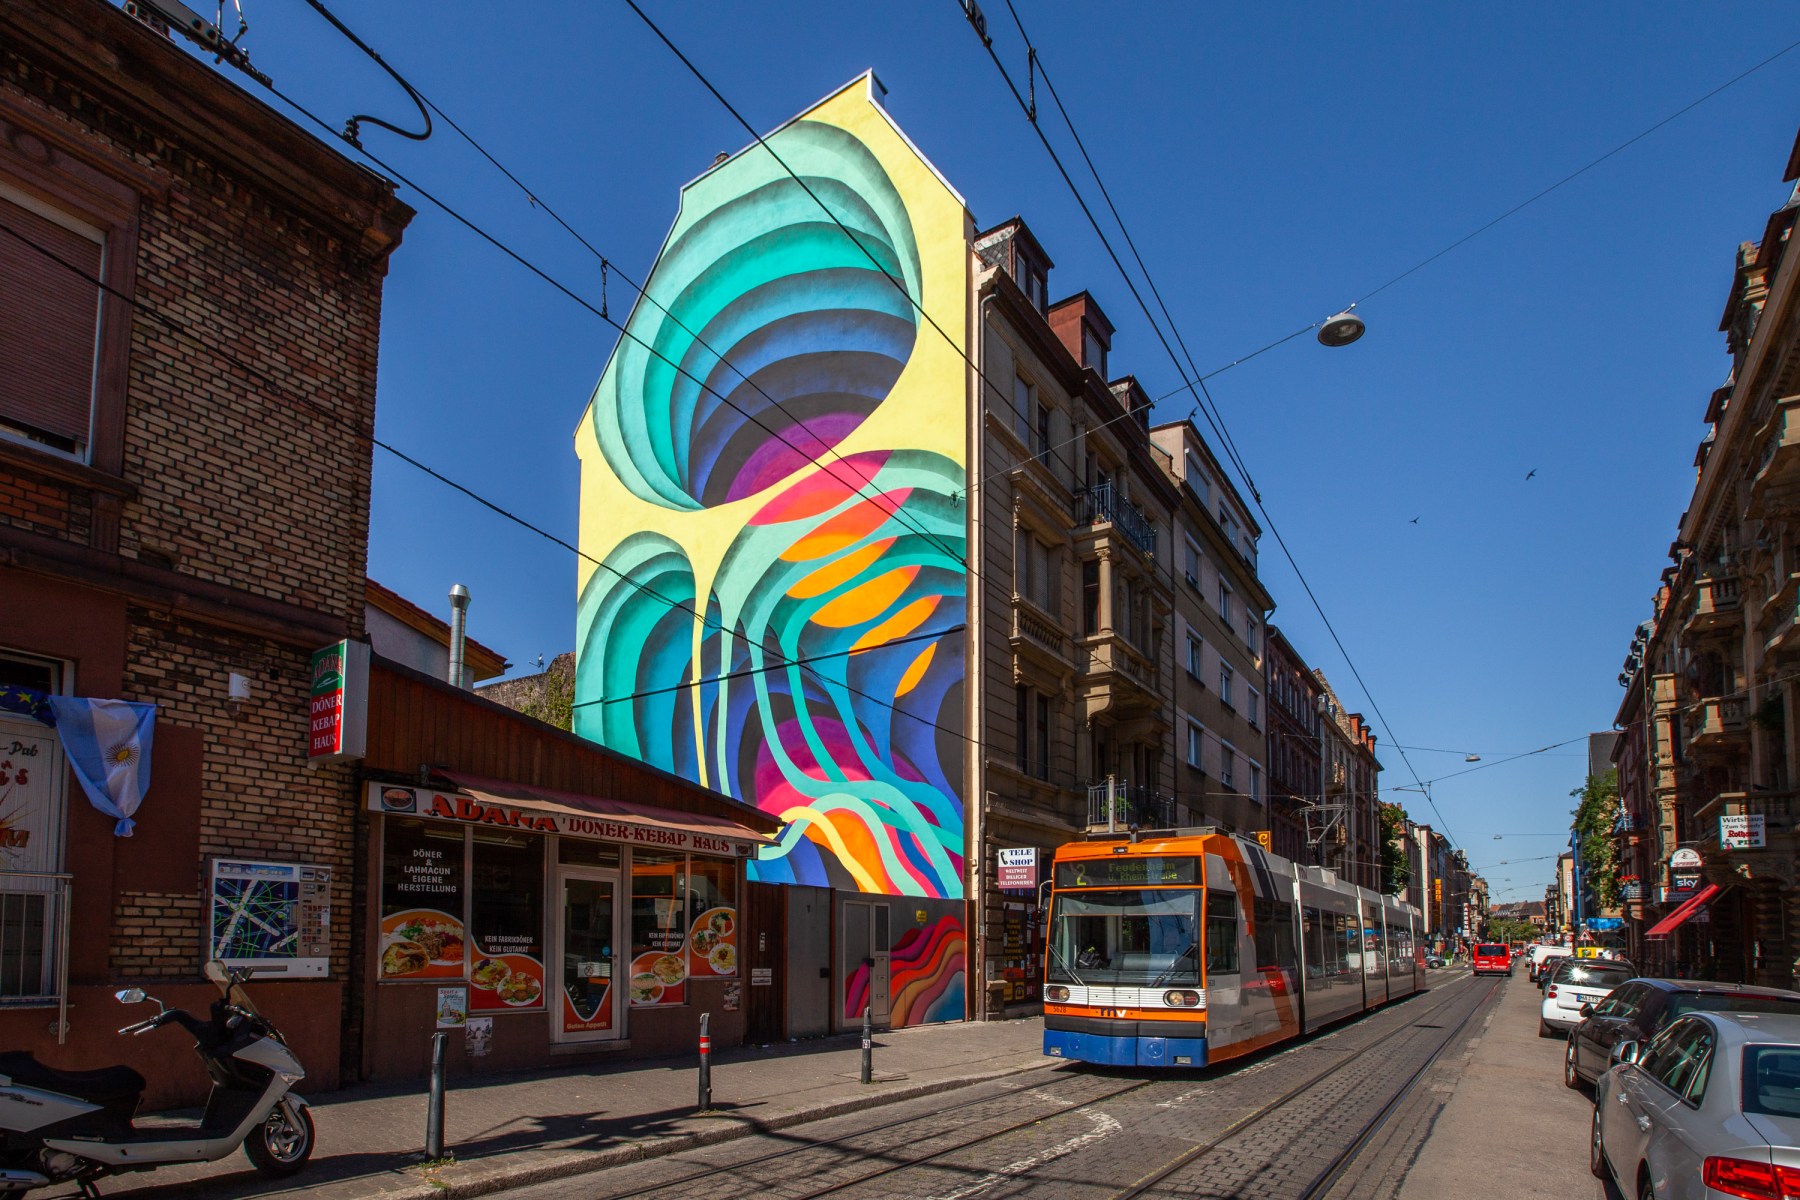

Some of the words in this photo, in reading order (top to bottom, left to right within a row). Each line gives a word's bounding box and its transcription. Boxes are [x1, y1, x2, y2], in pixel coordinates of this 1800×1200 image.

[313, 653, 343, 686] ADANA
[312, 694, 342, 713] DÖNER
[312, 713, 340, 731] KEBAP
[314, 733, 336, 749] HAUS
[423, 794, 560, 832] ADANA
[692, 836, 730, 853] HAUS
[413, 848, 442, 858] DÖNER
[404, 865, 451, 876] LAHMACUN
[1109, 862, 1175, 873] Feudenheim
[412, 875, 443, 884] EIGENE
[1076, 863, 1087, 886] 2
[397, 883, 457, 893] HERSTELLUNG
[1677, 878, 1698, 889] sky
[484, 935, 497, 943] KEIN
[498, 935, 533, 944] FABRIKDÖNER
